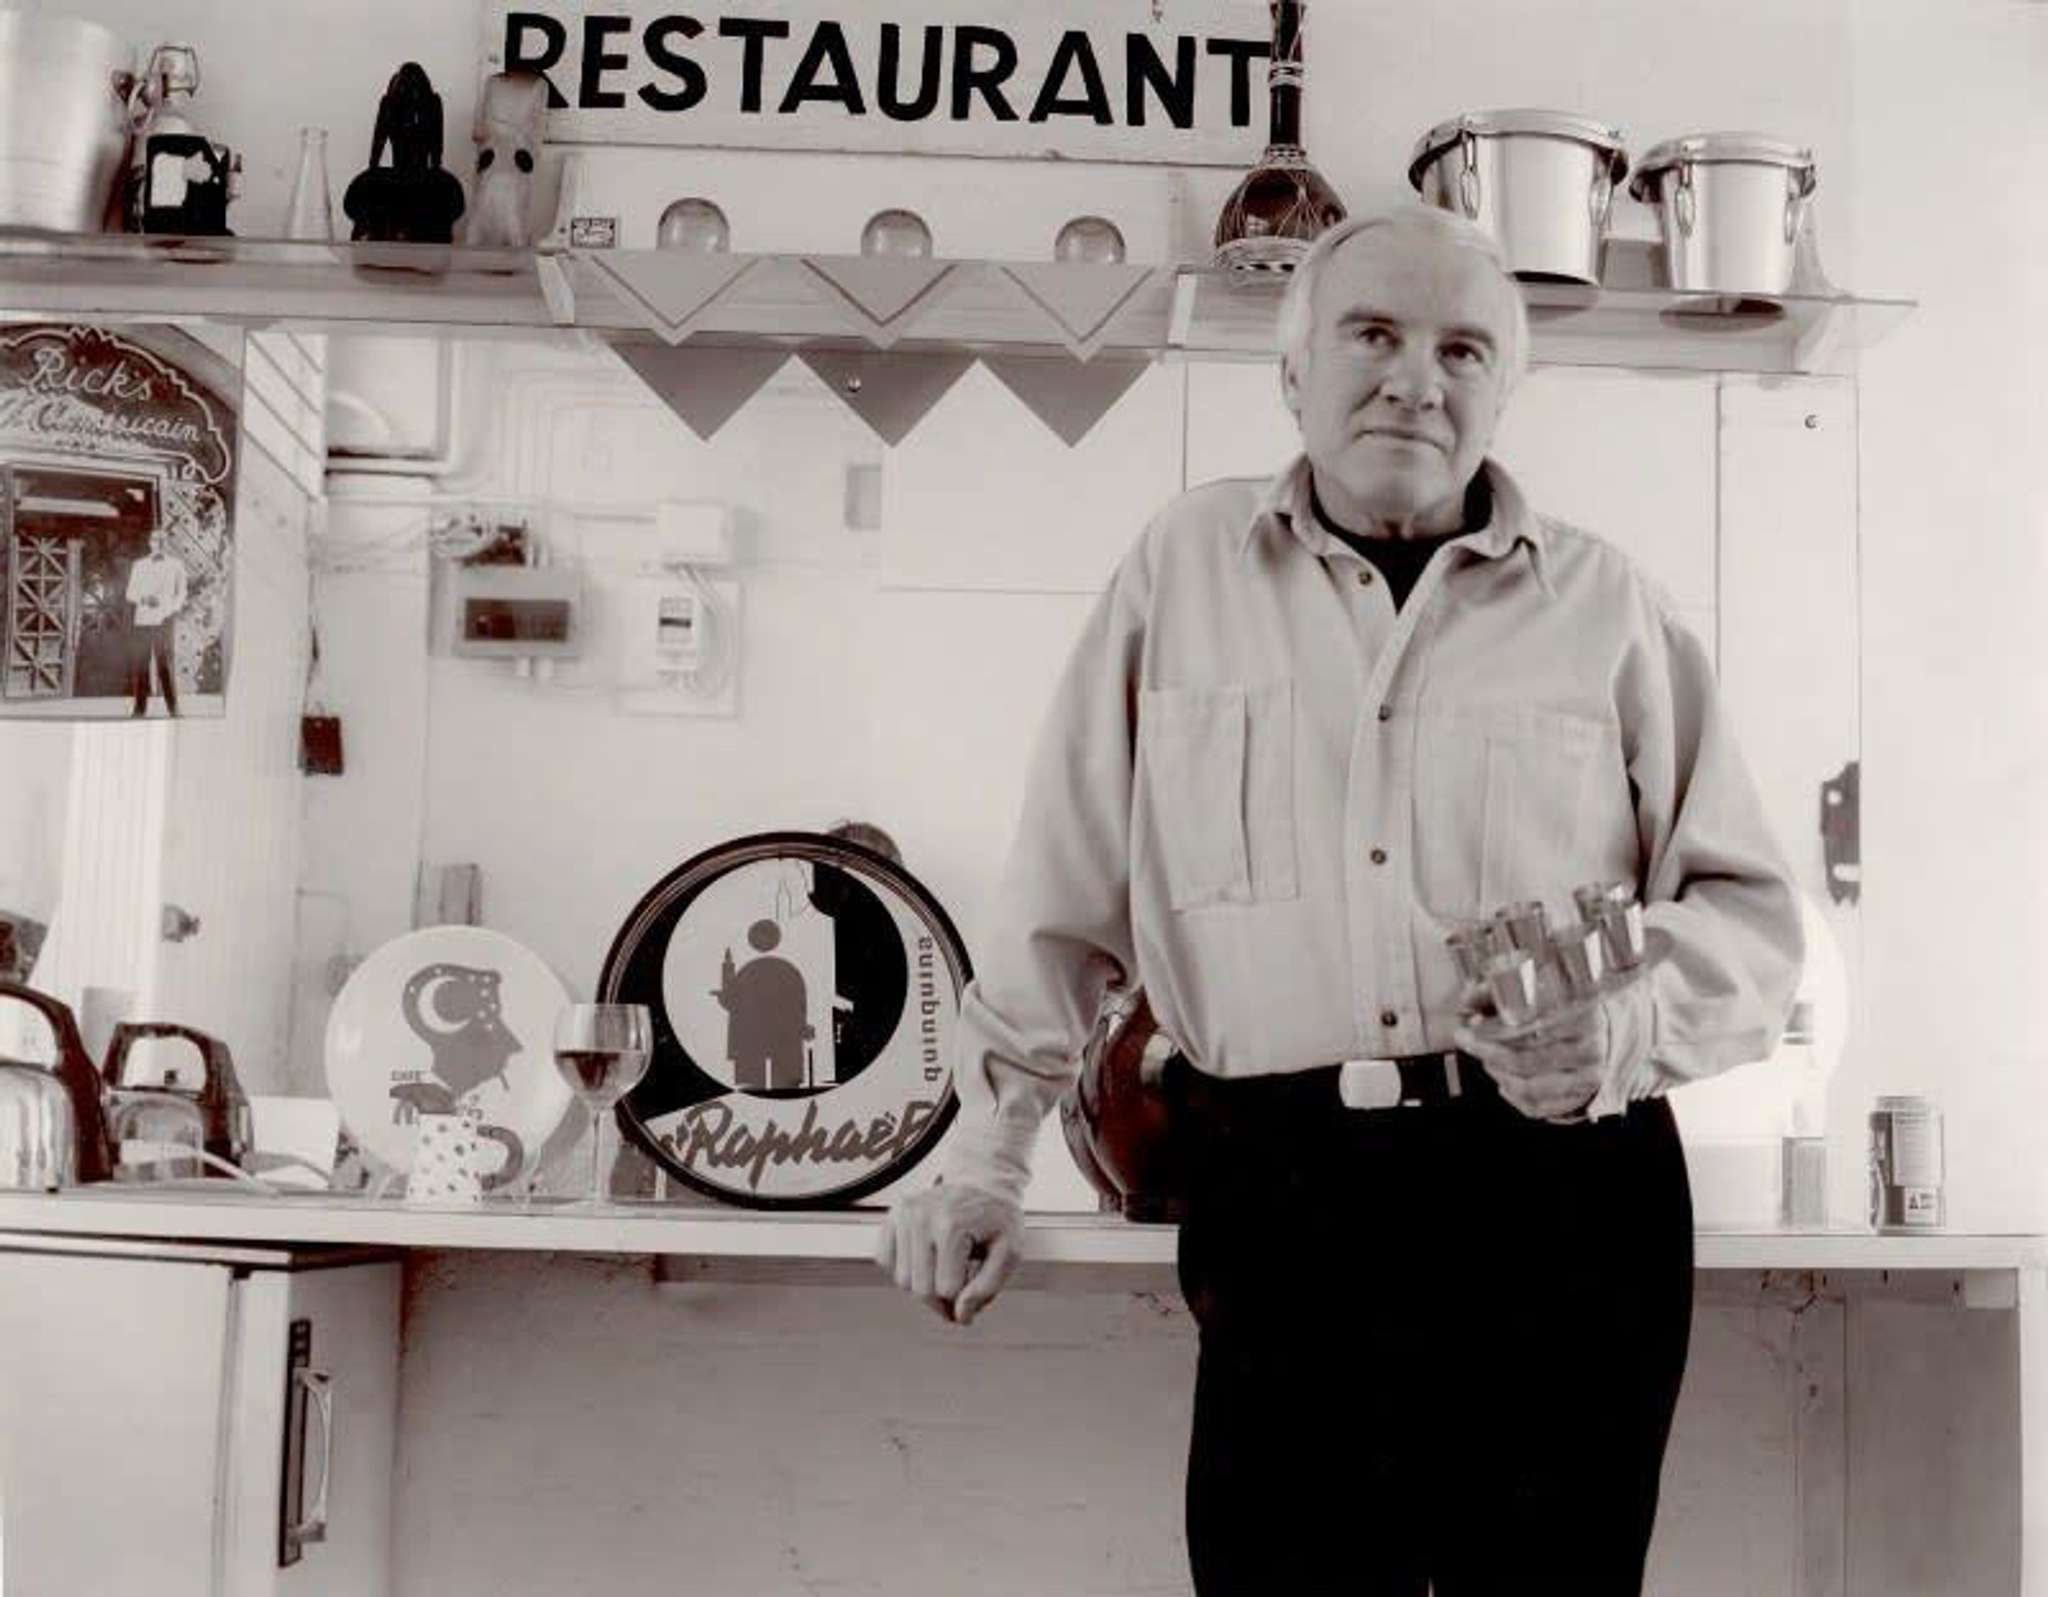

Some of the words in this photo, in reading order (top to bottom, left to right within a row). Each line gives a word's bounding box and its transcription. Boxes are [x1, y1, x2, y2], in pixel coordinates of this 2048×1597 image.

[505, 12, 1269, 128] RESTAURANT
[19, 346, 153, 401] Rick's
[918, 935, 943, 1083] quinquina
